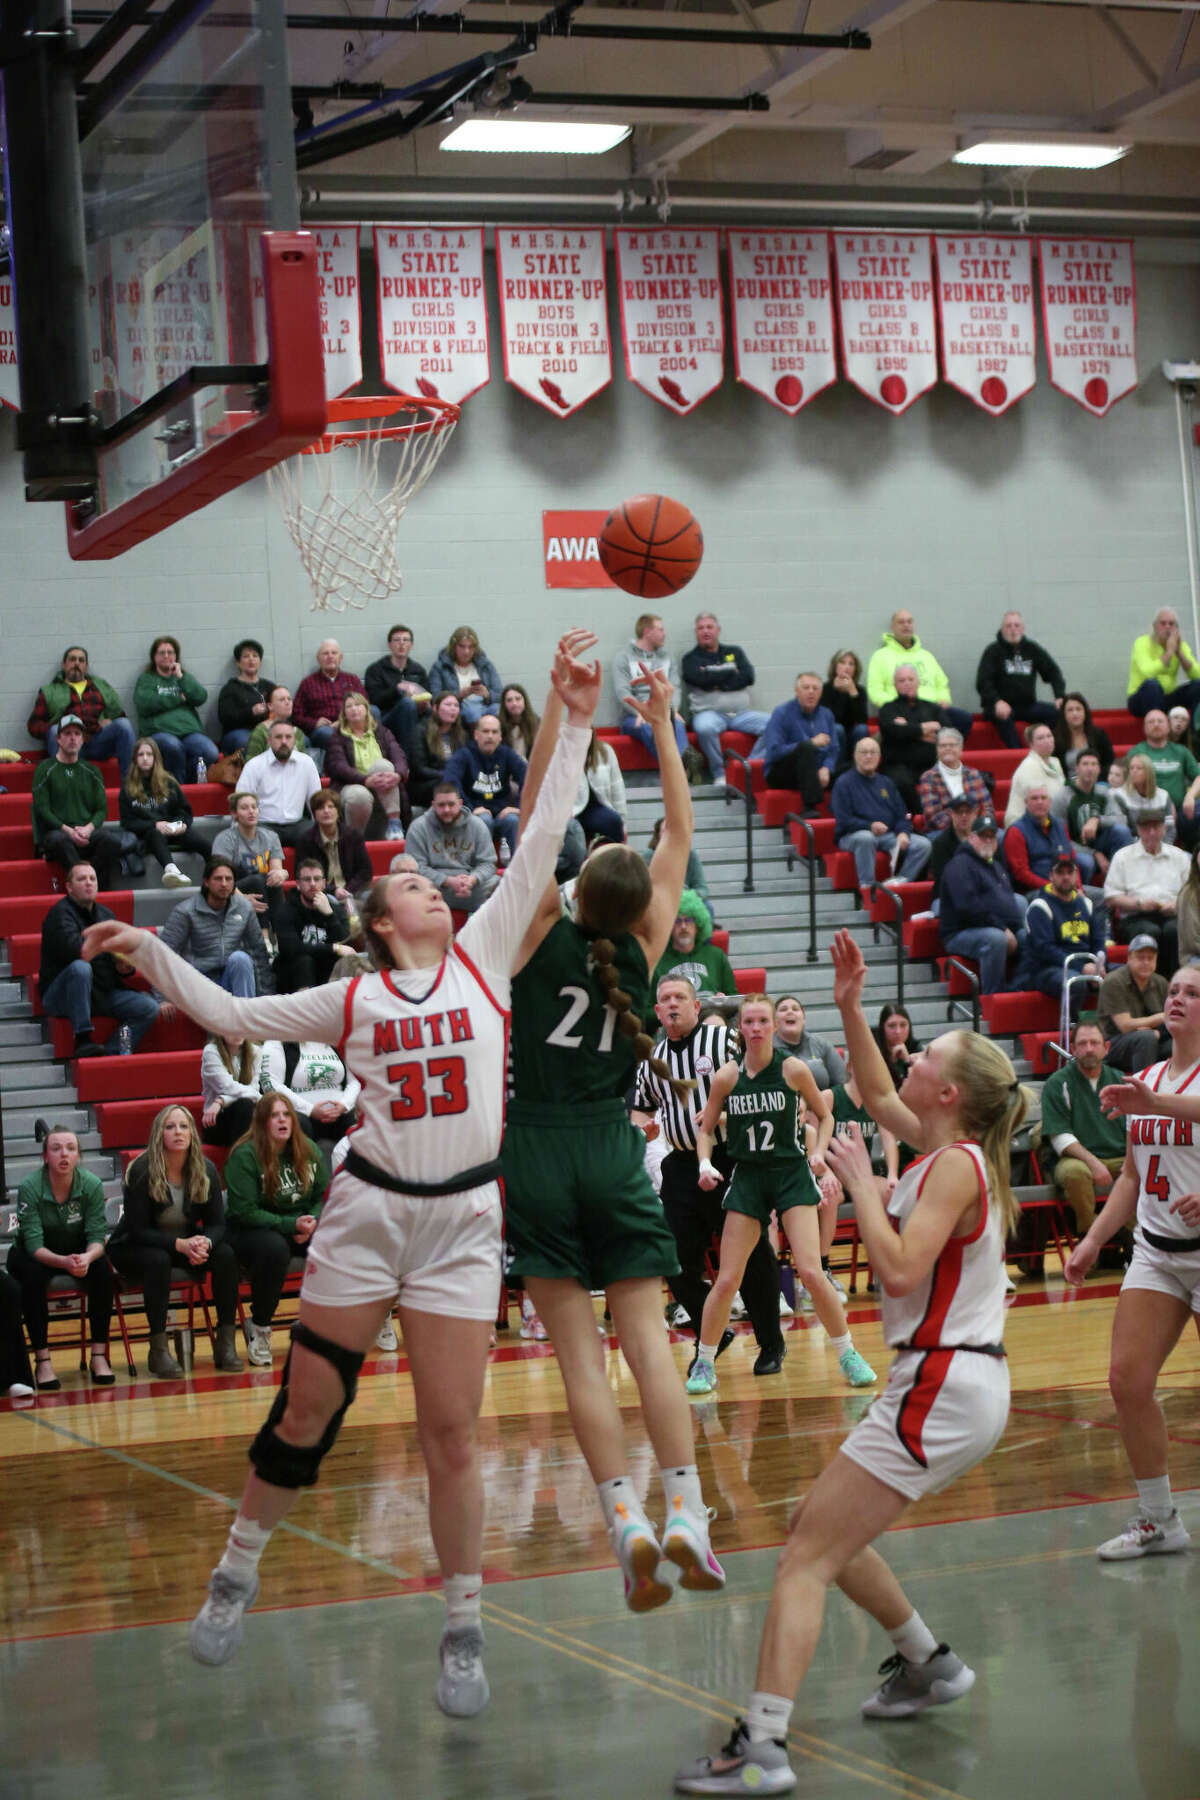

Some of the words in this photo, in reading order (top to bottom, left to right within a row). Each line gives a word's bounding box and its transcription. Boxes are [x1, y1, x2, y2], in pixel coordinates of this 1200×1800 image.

[402, 252, 460, 273] STATE
[524, 254, 581, 275] STATE
[642, 255, 697, 275] STATE
[754, 255, 808, 275] STATE
[858, 257, 911, 277] STATE
[959, 259, 1012, 279] STATE
[1063, 262, 1113, 282] STATE
[382, 277, 482, 298] RUNNER-UP
[505, 279, 605, 300] RUNNER-UP
[623, 279, 719, 300] RUNNER-UP
[736, 279, 830, 300] RUNNER-UP
[841, 280, 932, 301] RUNNER-UP
[943, 282, 1031, 304] RUNNER-UP
[1047, 285, 1133, 305] RUNNER-UP
[412, 302, 455, 316] GIRLS
[538, 304, 575, 320] BOYS
[656, 304, 692, 319] BOYS
[764, 303, 805, 318] GIRLS
[868, 303, 907, 318] GIRLS
[969, 305, 1008, 320] GIRLS
[1073, 308, 1109, 322] GIRLS
[393, 320, 456, 335] DIVISION
[467, 320, 476, 335] 3
[516, 322, 578, 337] DIVISION
[589, 322, 599, 336] 3
[636, 322, 697, 337] DIVISION
[706, 321, 715, 336] 3
[754, 321, 799, 336] CLASS
[859, 322, 903, 336] CLASS
[960, 323, 1002, 338] CLASS
[1064, 326, 1107, 340] CLASS
[385, 339, 428, 354] TRACK
[447, 339, 487, 354] FIELD
[509, 340, 555, 355] TRACK
[570, 341, 609, 355] FIELD
[629, 339, 670, 355] TRACK
[687, 339, 722, 354] FIELD
[743, 338, 829, 353] BASKETBALL
[849, 338, 932, 354] BASKETBALL
[950, 341, 1032, 356] BASKETBALL
[1054, 342, 1133, 358] BASKETBALL
[420, 358, 454, 373] 2011
[542, 359, 578, 373] 2010
[659, 357, 698, 371] 2004
[547, 537, 600, 562] AWA
[545, 985, 618, 1052] 21
[373, 1007, 475, 1056] MUTH
[386, 1055, 469, 1122] 33
[728, 1090, 786, 1115] FREELAND
[746, 1120, 775, 1152] 12
[1146, 1154, 1171, 1202] 4
